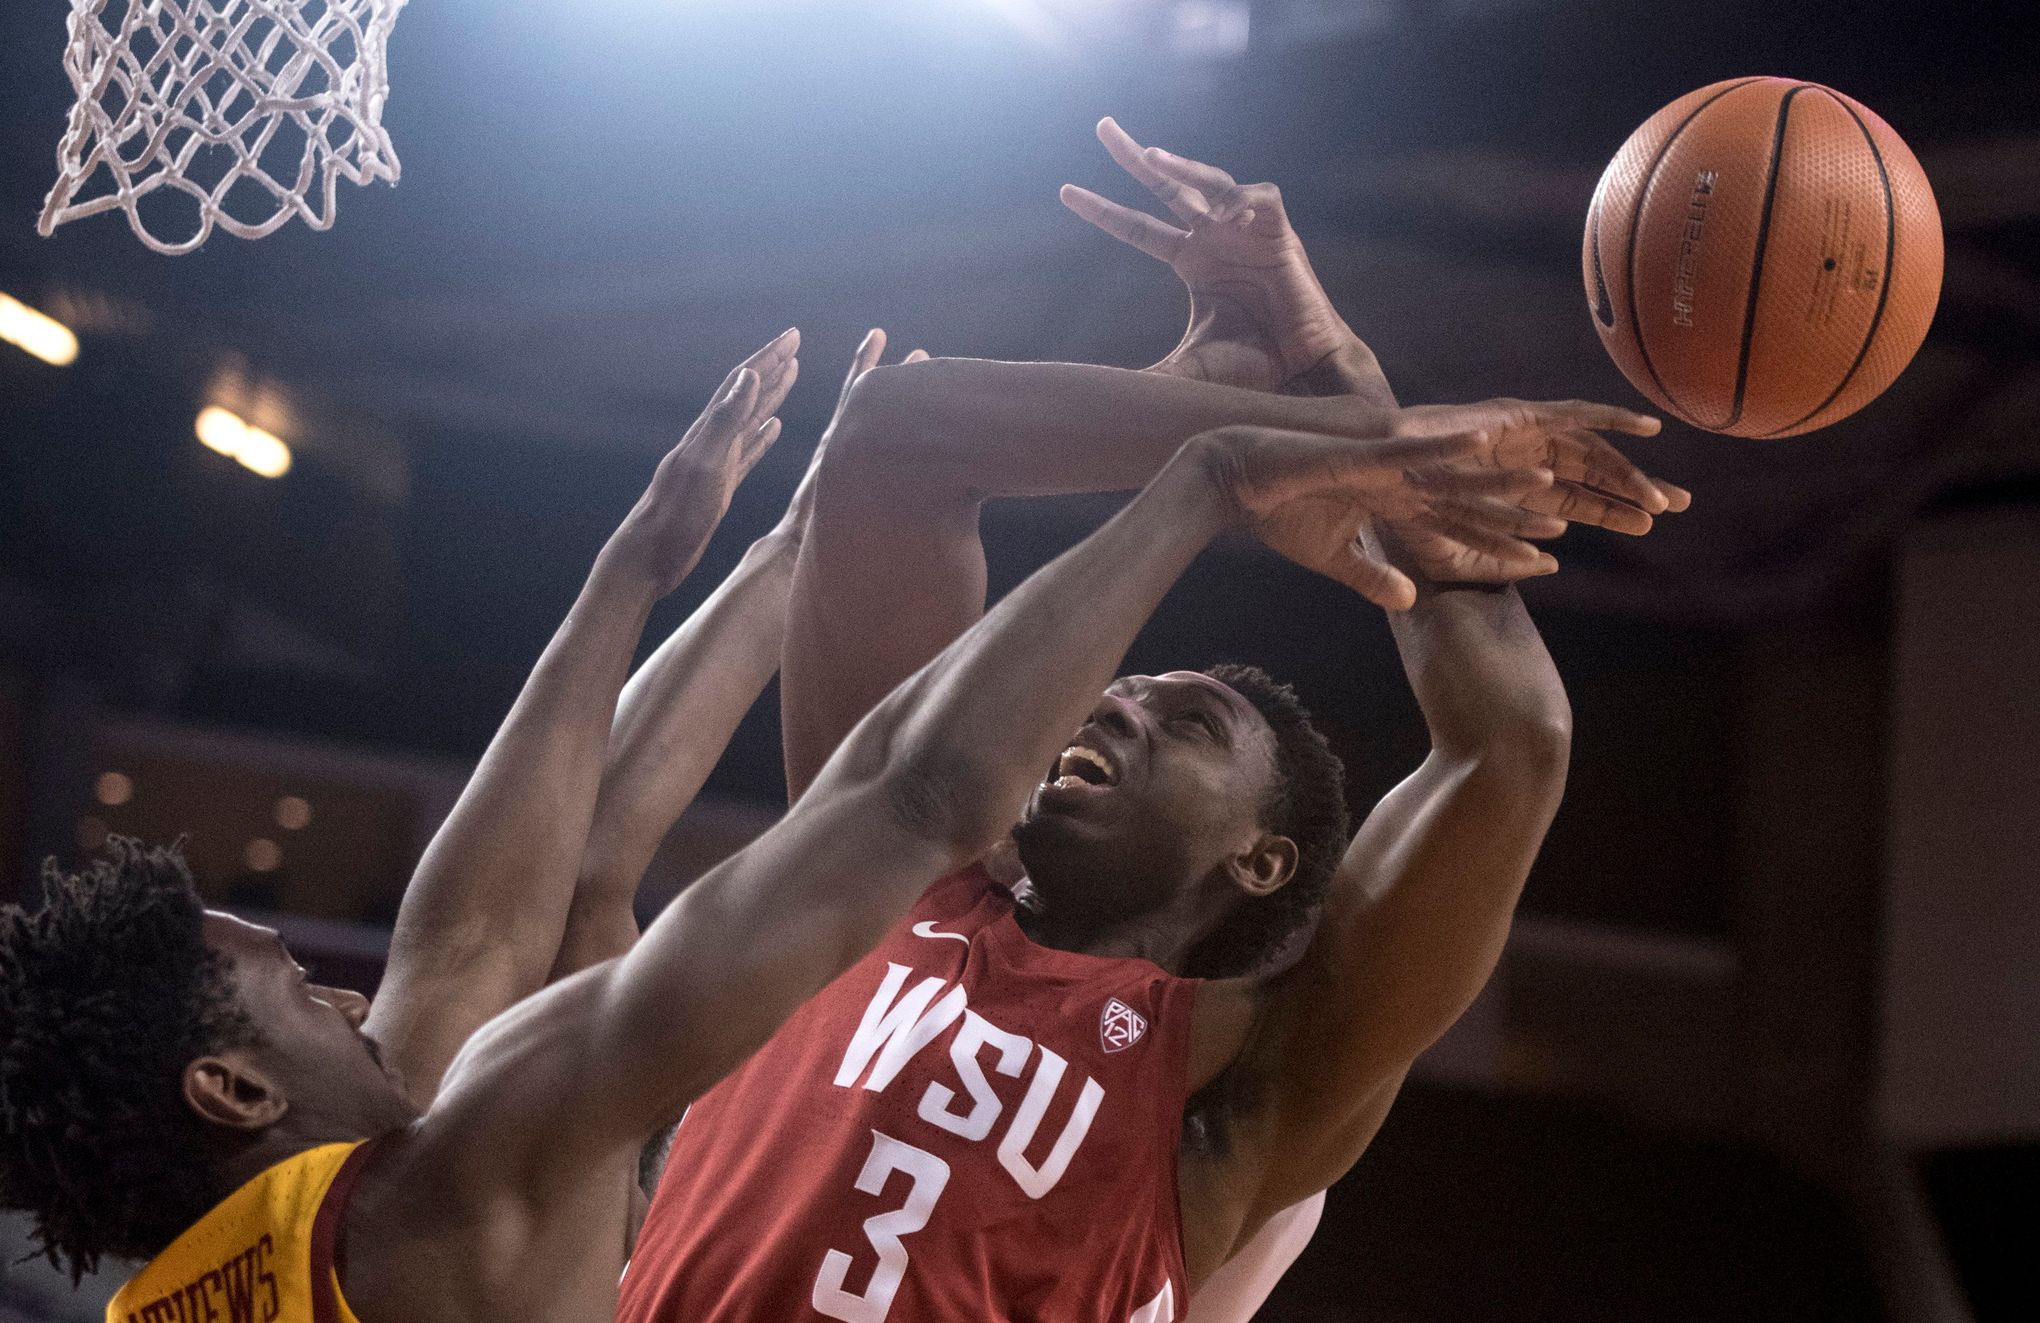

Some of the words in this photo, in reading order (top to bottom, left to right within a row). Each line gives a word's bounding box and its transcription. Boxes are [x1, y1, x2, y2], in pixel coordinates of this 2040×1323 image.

[833, 961, 1106, 1200] WSU
[1104, 1001, 1145, 1043] PAC
[1104, 1022, 1129, 1047] 12
[812, 1128, 951, 1323] 3
